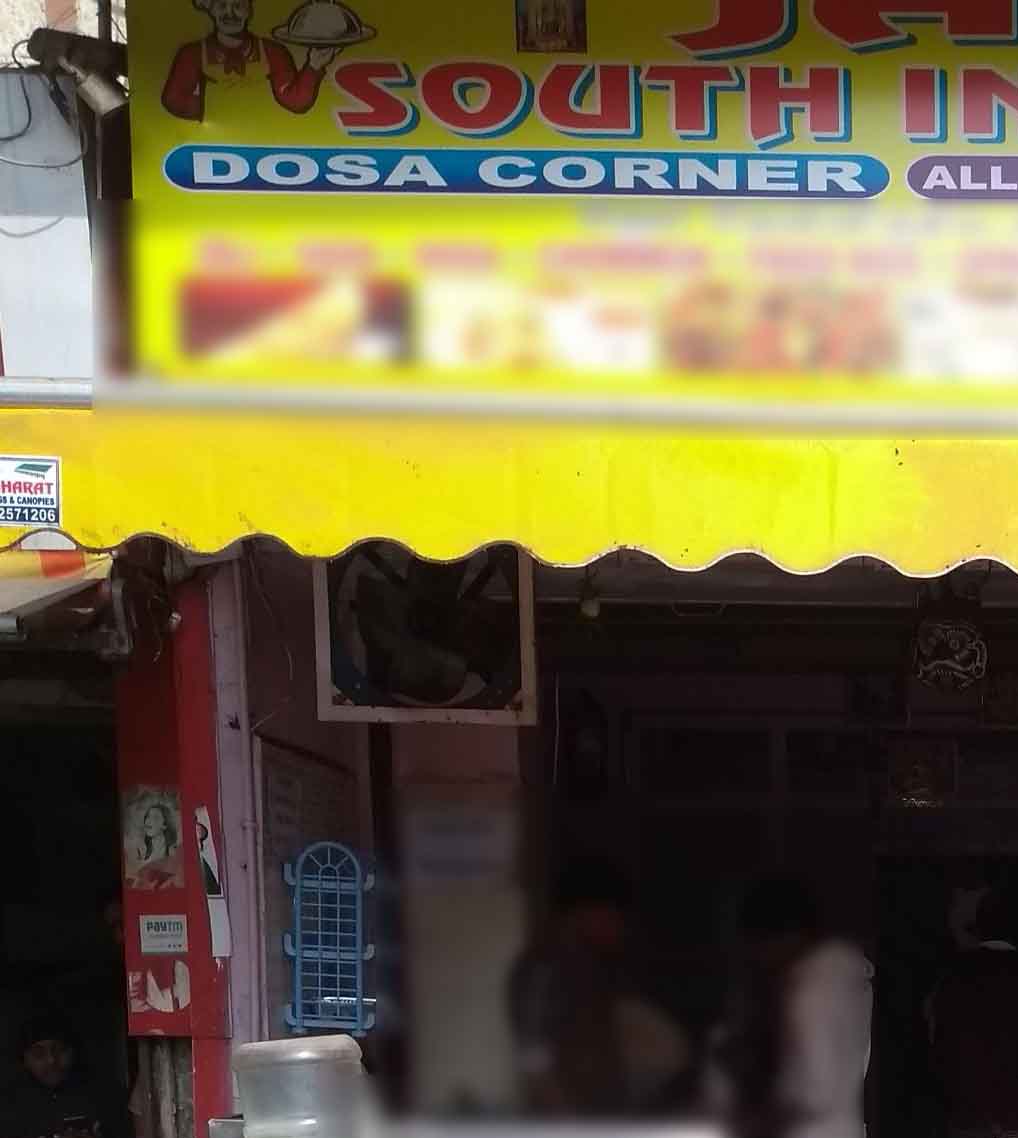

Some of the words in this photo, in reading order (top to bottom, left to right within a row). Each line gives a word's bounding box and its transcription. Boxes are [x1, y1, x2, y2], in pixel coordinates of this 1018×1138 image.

[335, 61, 852, 151] SOUTH
[193, 152, 448, 187] DOSA
[478, 156, 865, 193] CORNER
[922, 165, 1018, 191] ALL
[0, 480, 54, 495] HARAT
